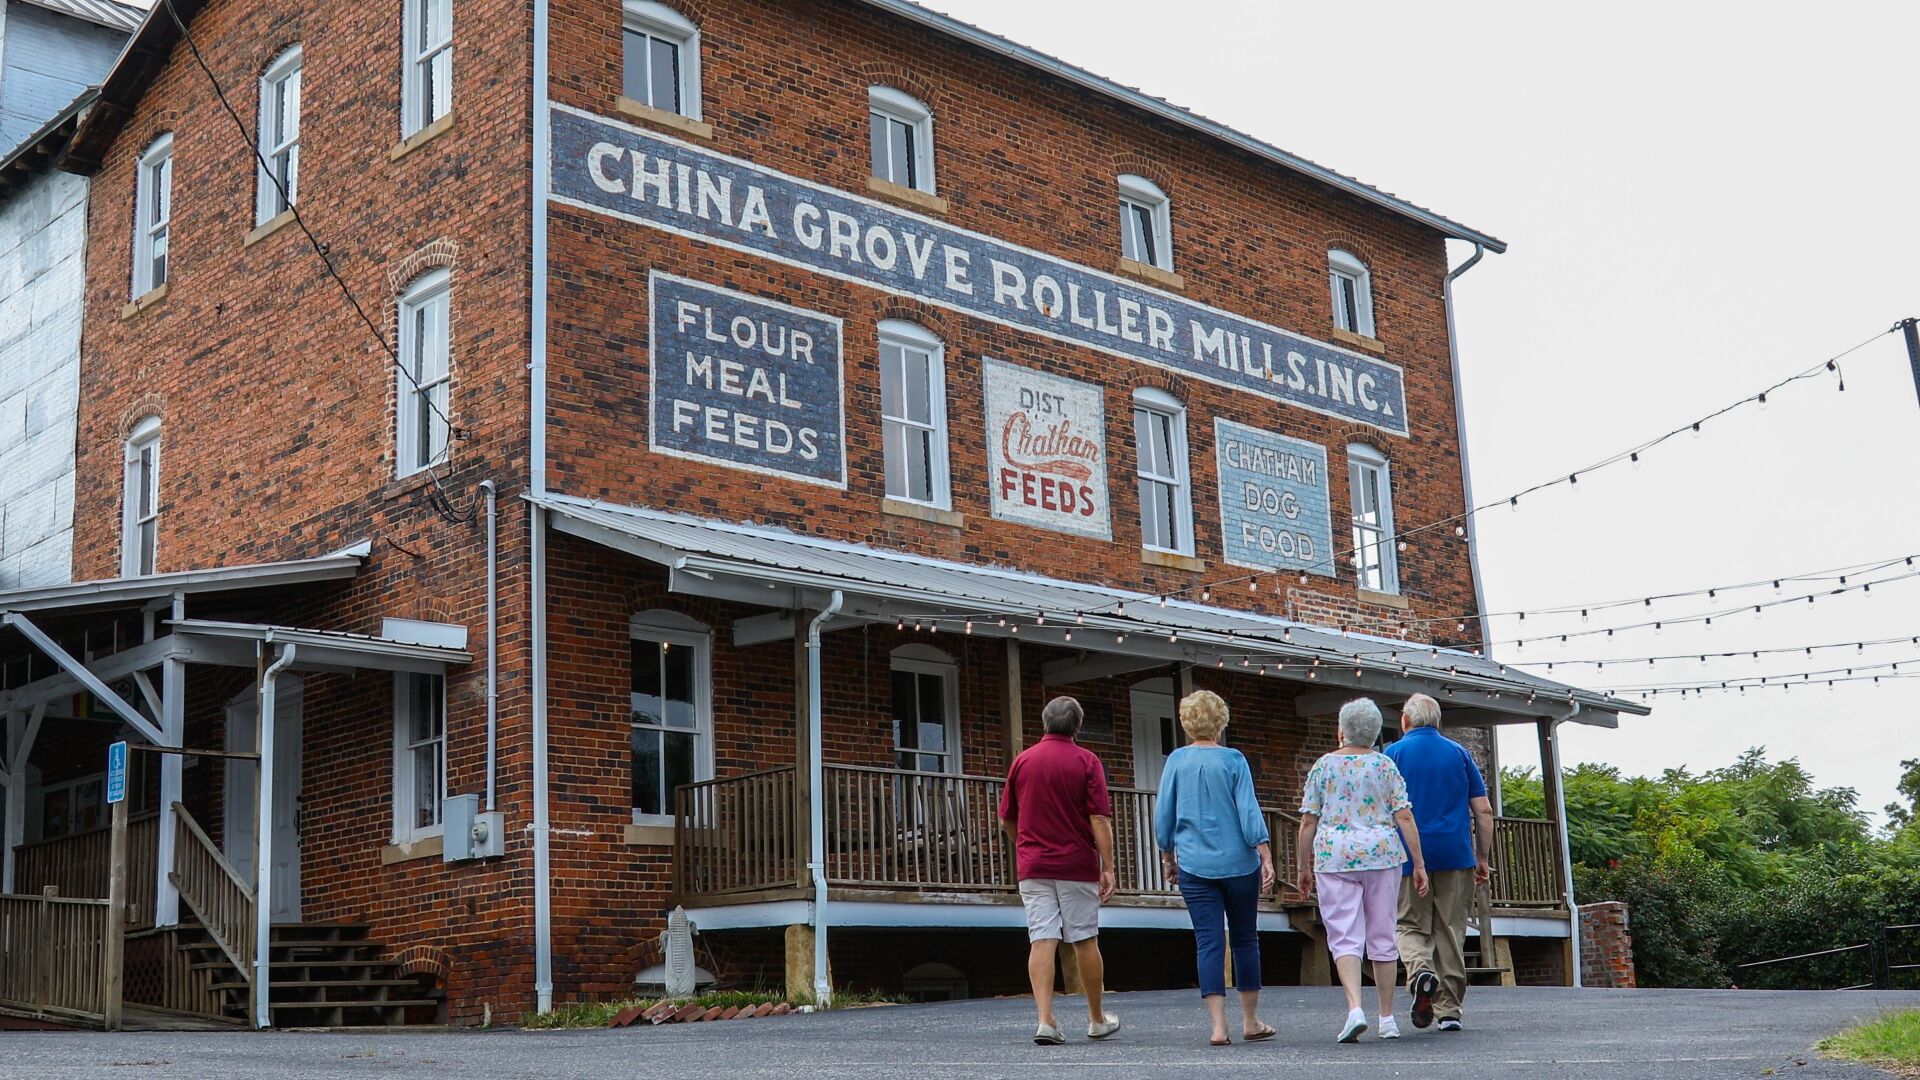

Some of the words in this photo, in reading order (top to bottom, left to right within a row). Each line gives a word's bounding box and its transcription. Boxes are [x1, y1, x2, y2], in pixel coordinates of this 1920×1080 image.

[587, 142, 777, 239] CHINA
[792, 201, 974, 295] GROVE
[991, 259, 1176, 353] ROLLER
[677, 300, 815, 365] FLOUR
[686, 350, 802, 410] MEAL
[1019, 386, 1068, 418] DIST.
[673, 398, 818, 460] FEEDS
[1002, 411, 1099, 480] Chatham
[1225, 439, 1317, 487] CHATHAM
[1000, 467, 1095, 517] FEEDS
[1244, 481, 1301, 520] DOG
[1241, 521, 1314, 561] FOOD
